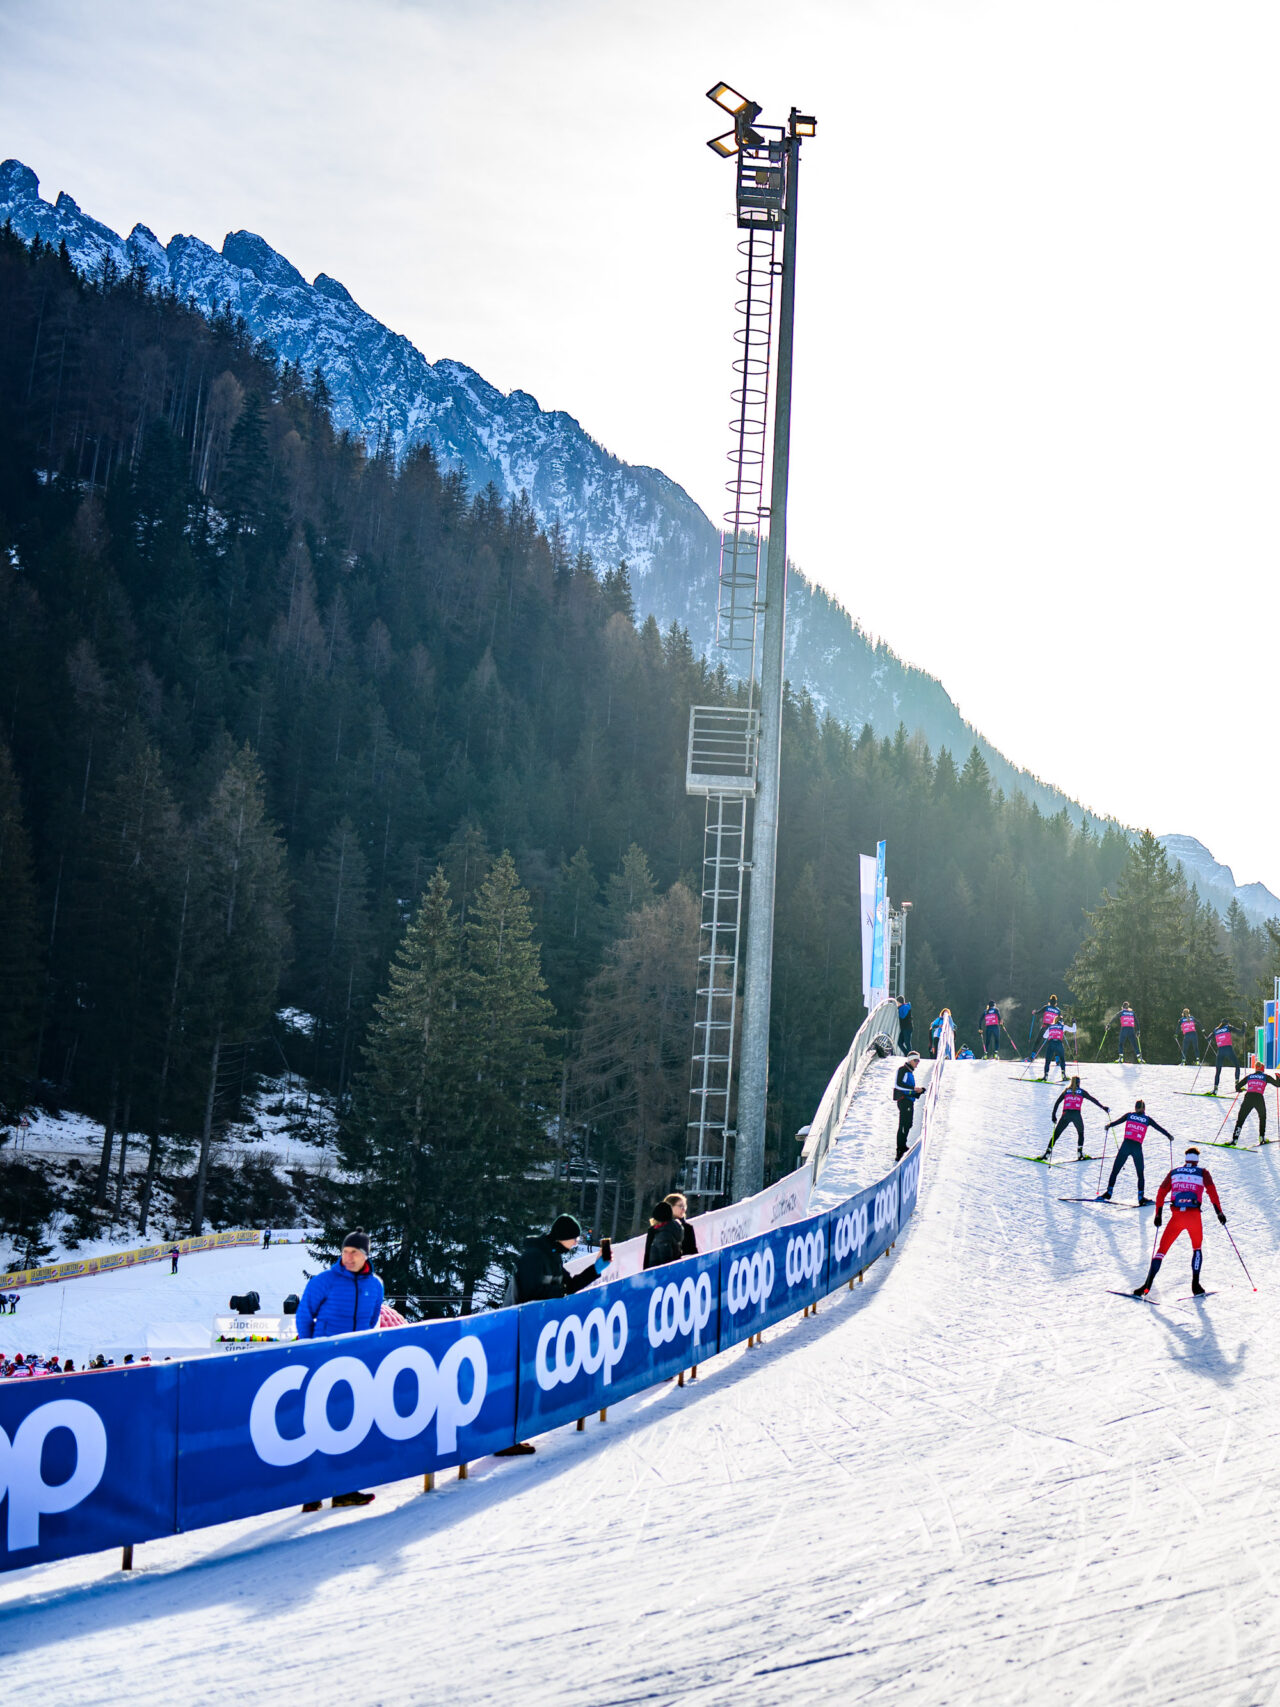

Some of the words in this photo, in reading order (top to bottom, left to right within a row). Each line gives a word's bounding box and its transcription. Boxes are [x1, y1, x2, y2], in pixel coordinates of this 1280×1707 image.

[786, 1229, 824, 1288] coop
[835, 1203, 868, 1262] coop
[648, 1272, 712, 1347] coop
[727, 1248, 775, 1314] coop
[536, 1301, 628, 1390] coop
[250, 1336, 488, 1468] coop
